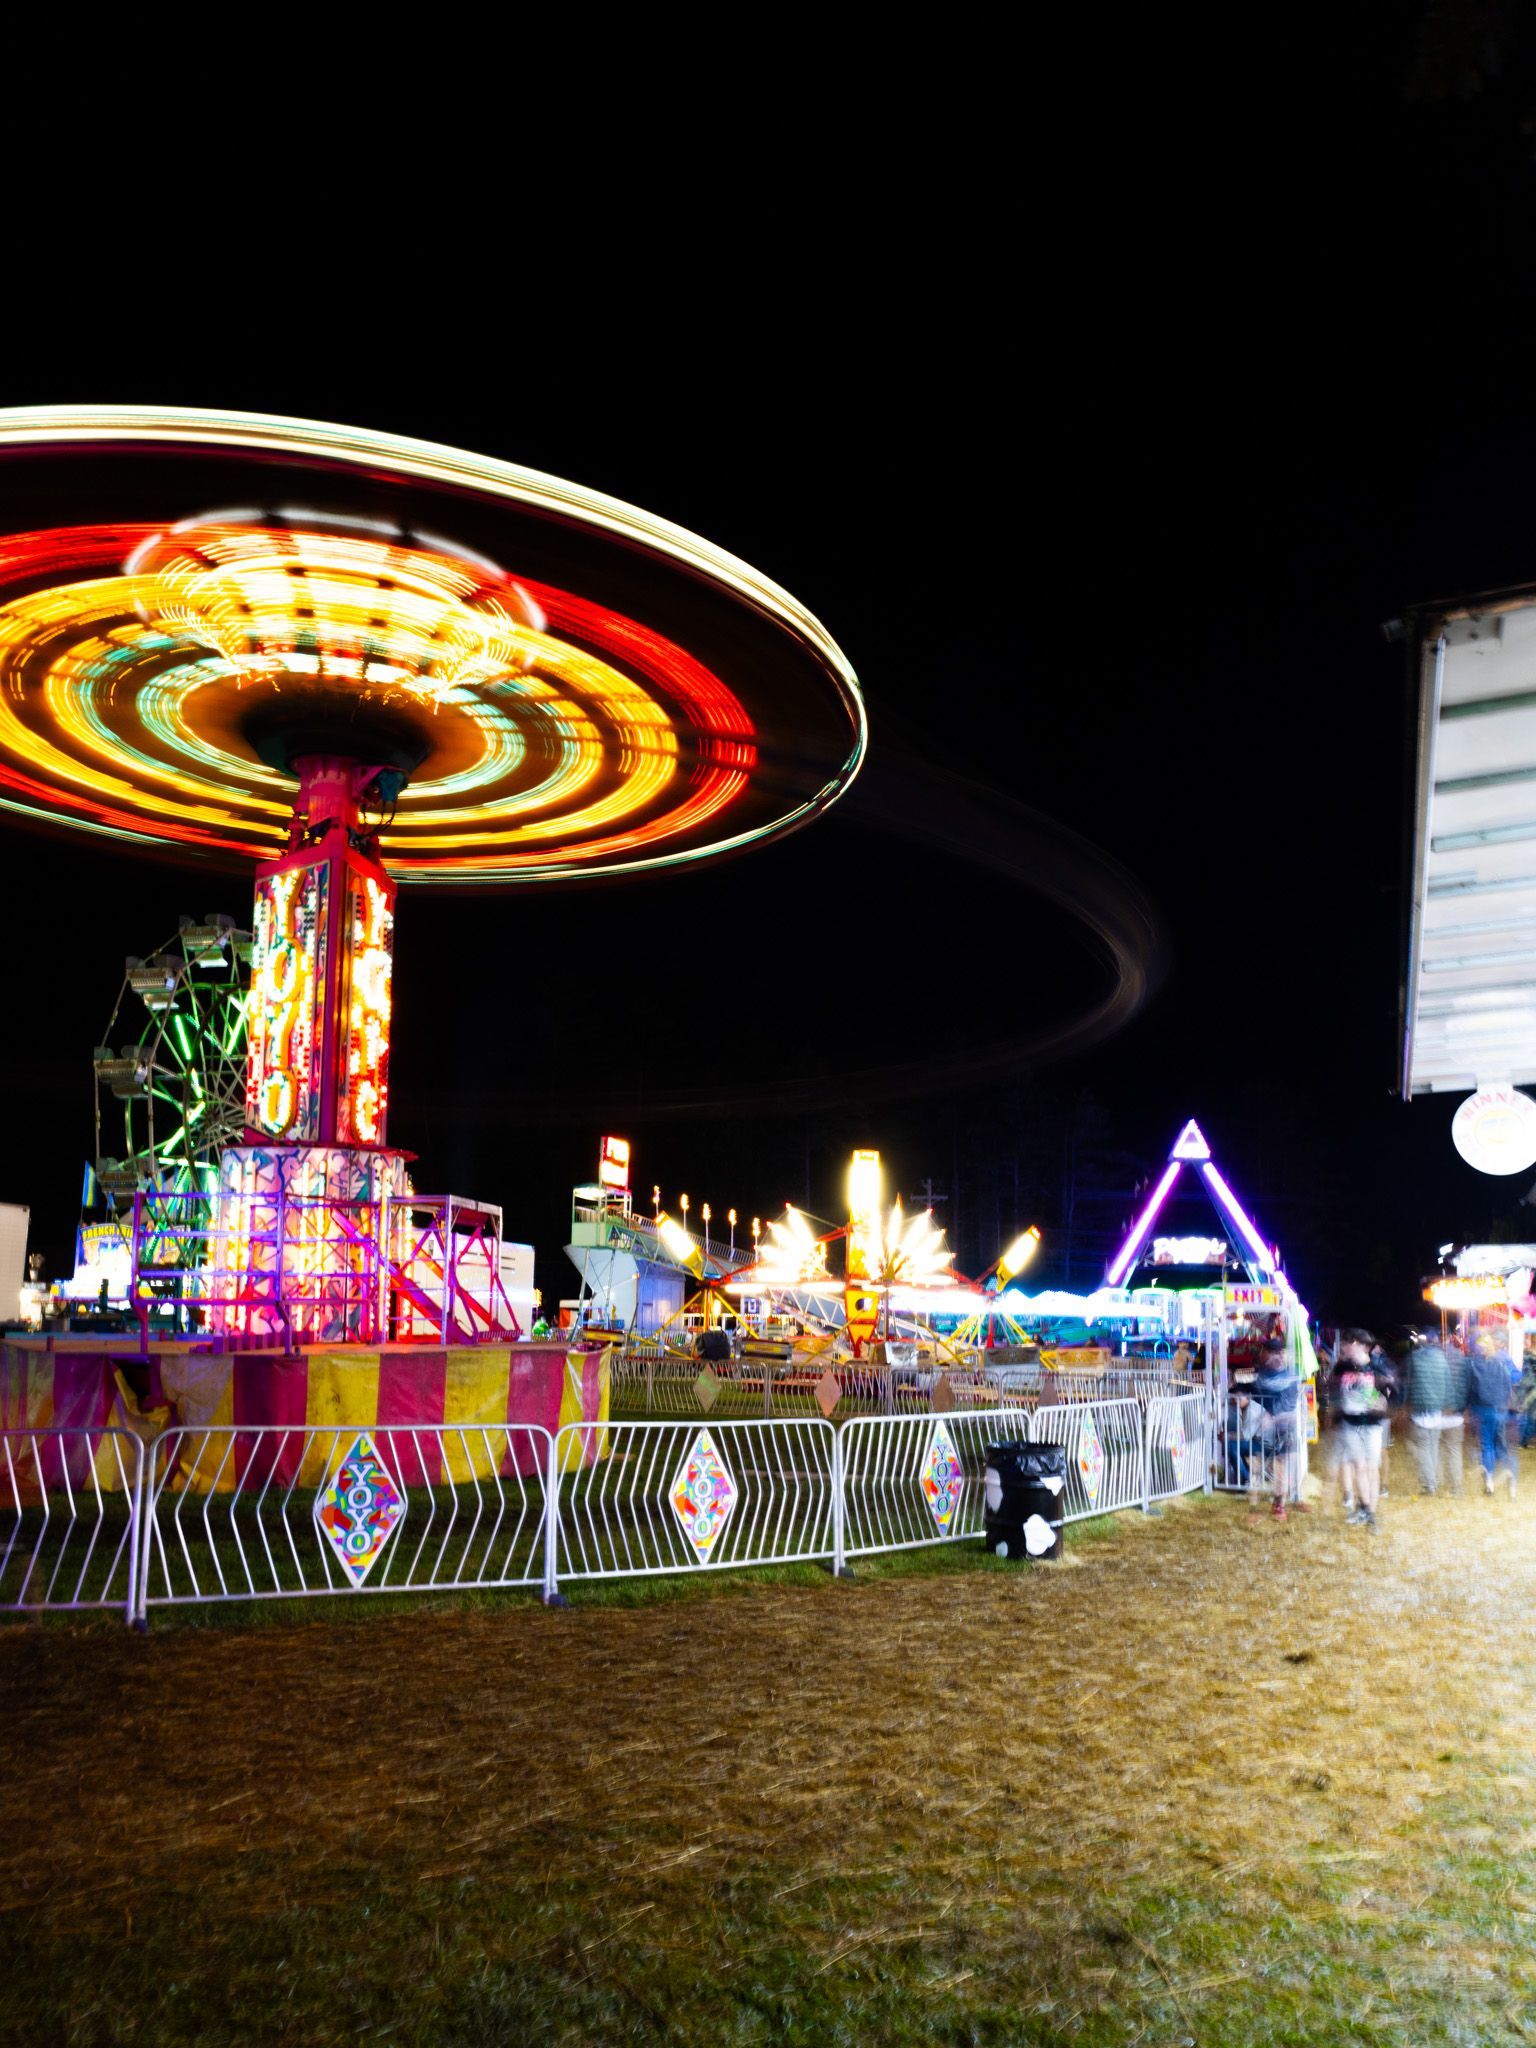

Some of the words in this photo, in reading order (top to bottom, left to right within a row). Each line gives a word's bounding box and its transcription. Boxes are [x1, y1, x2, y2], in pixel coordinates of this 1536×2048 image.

[1234, 1289, 1263, 1303] EXIT
[346, 1464, 374, 1554] YOYO
[693, 1459, 712, 1537] YOYO
[937, 1446, 949, 1513] YOYO
